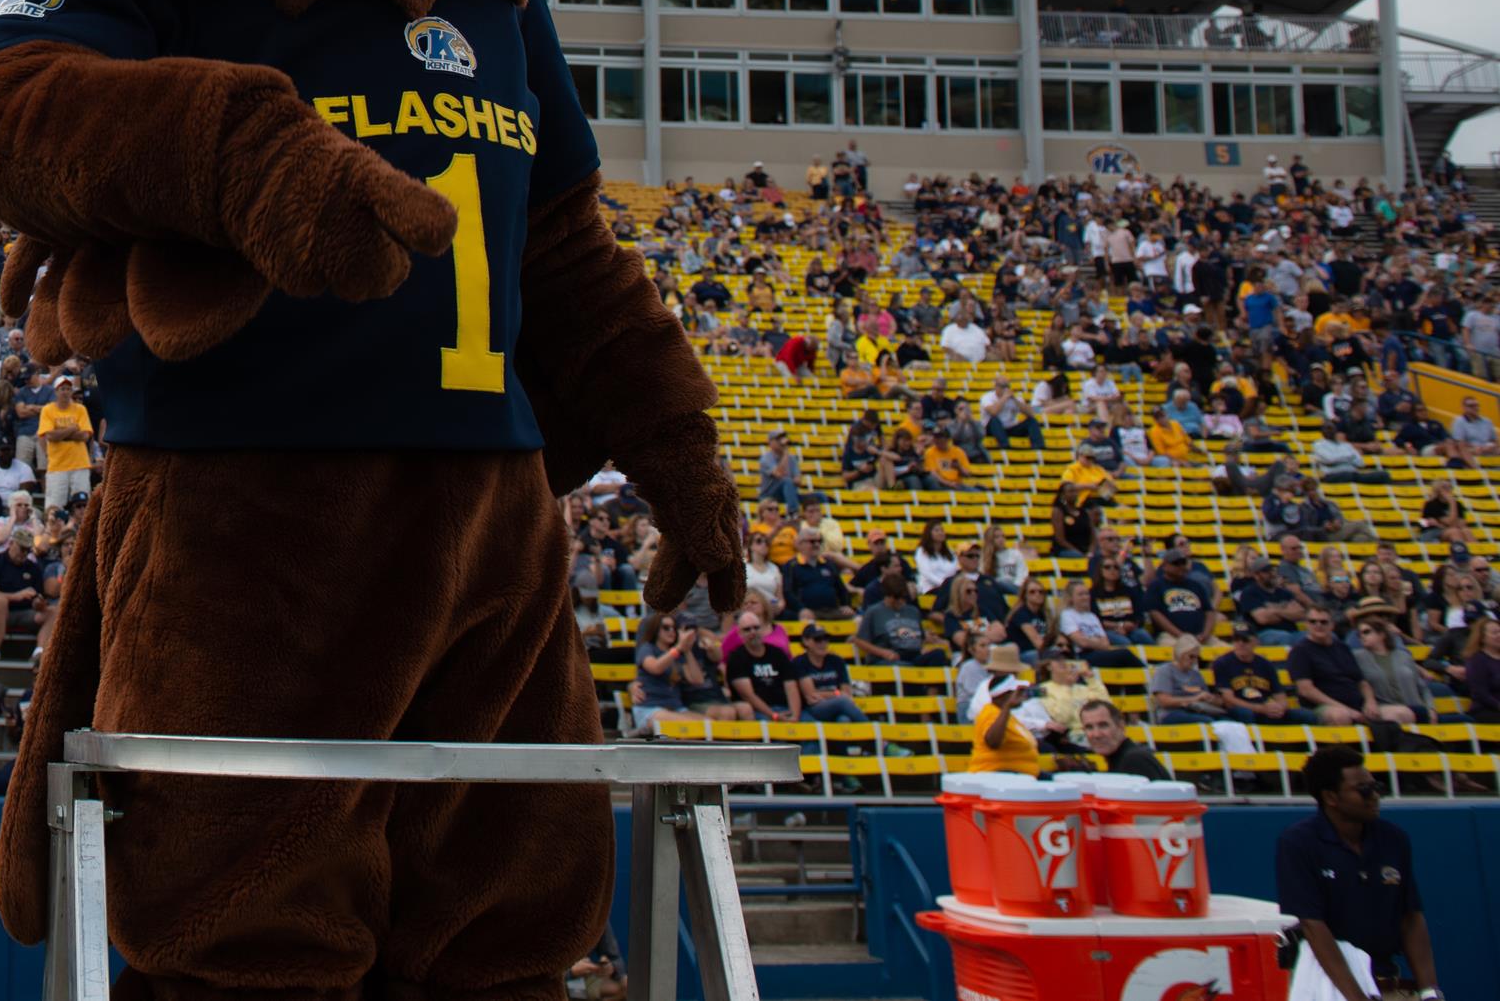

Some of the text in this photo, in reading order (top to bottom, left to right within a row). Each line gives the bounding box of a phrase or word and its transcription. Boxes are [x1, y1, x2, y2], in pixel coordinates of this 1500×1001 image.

[427, 28, 459, 62] K
[426, 61, 473, 76] KENT STATE
[313, 90, 537, 156] FLASHES
[1101, 152, 1124, 174] K
[425, 152, 506, 393] 1
[1038, 820, 1071, 857] G
[1159, 821, 1189, 857] G
